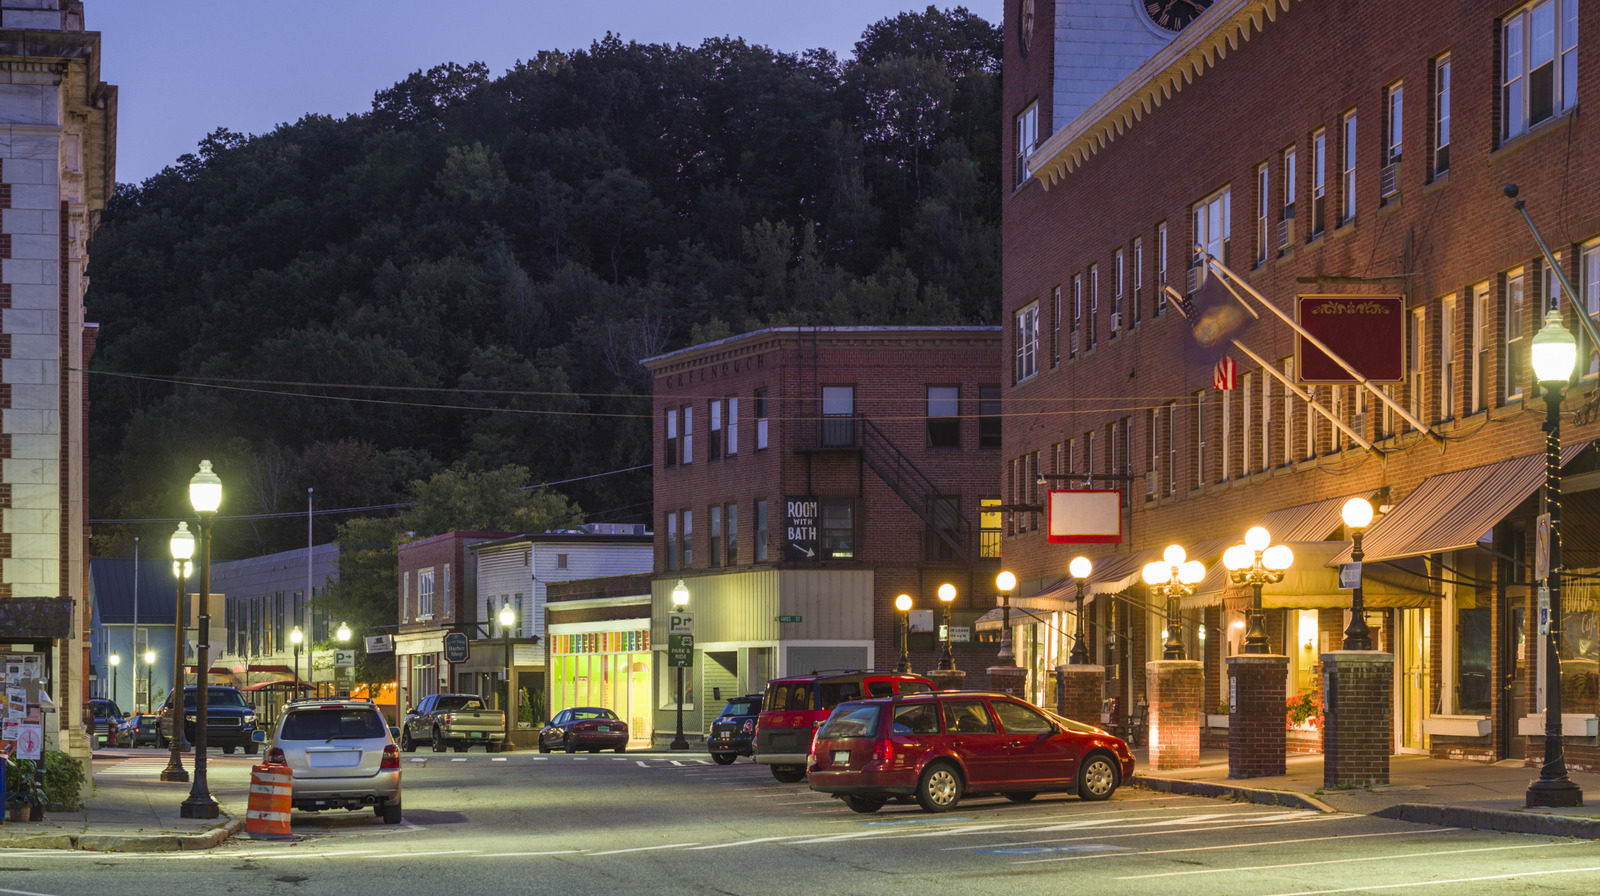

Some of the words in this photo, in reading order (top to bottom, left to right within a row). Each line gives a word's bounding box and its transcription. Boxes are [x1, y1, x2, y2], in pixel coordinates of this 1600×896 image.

[787, 501, 818, 518] ROOM
[793, 518, 813, 526] WITH
[787, 526, 817, 541] BATH
